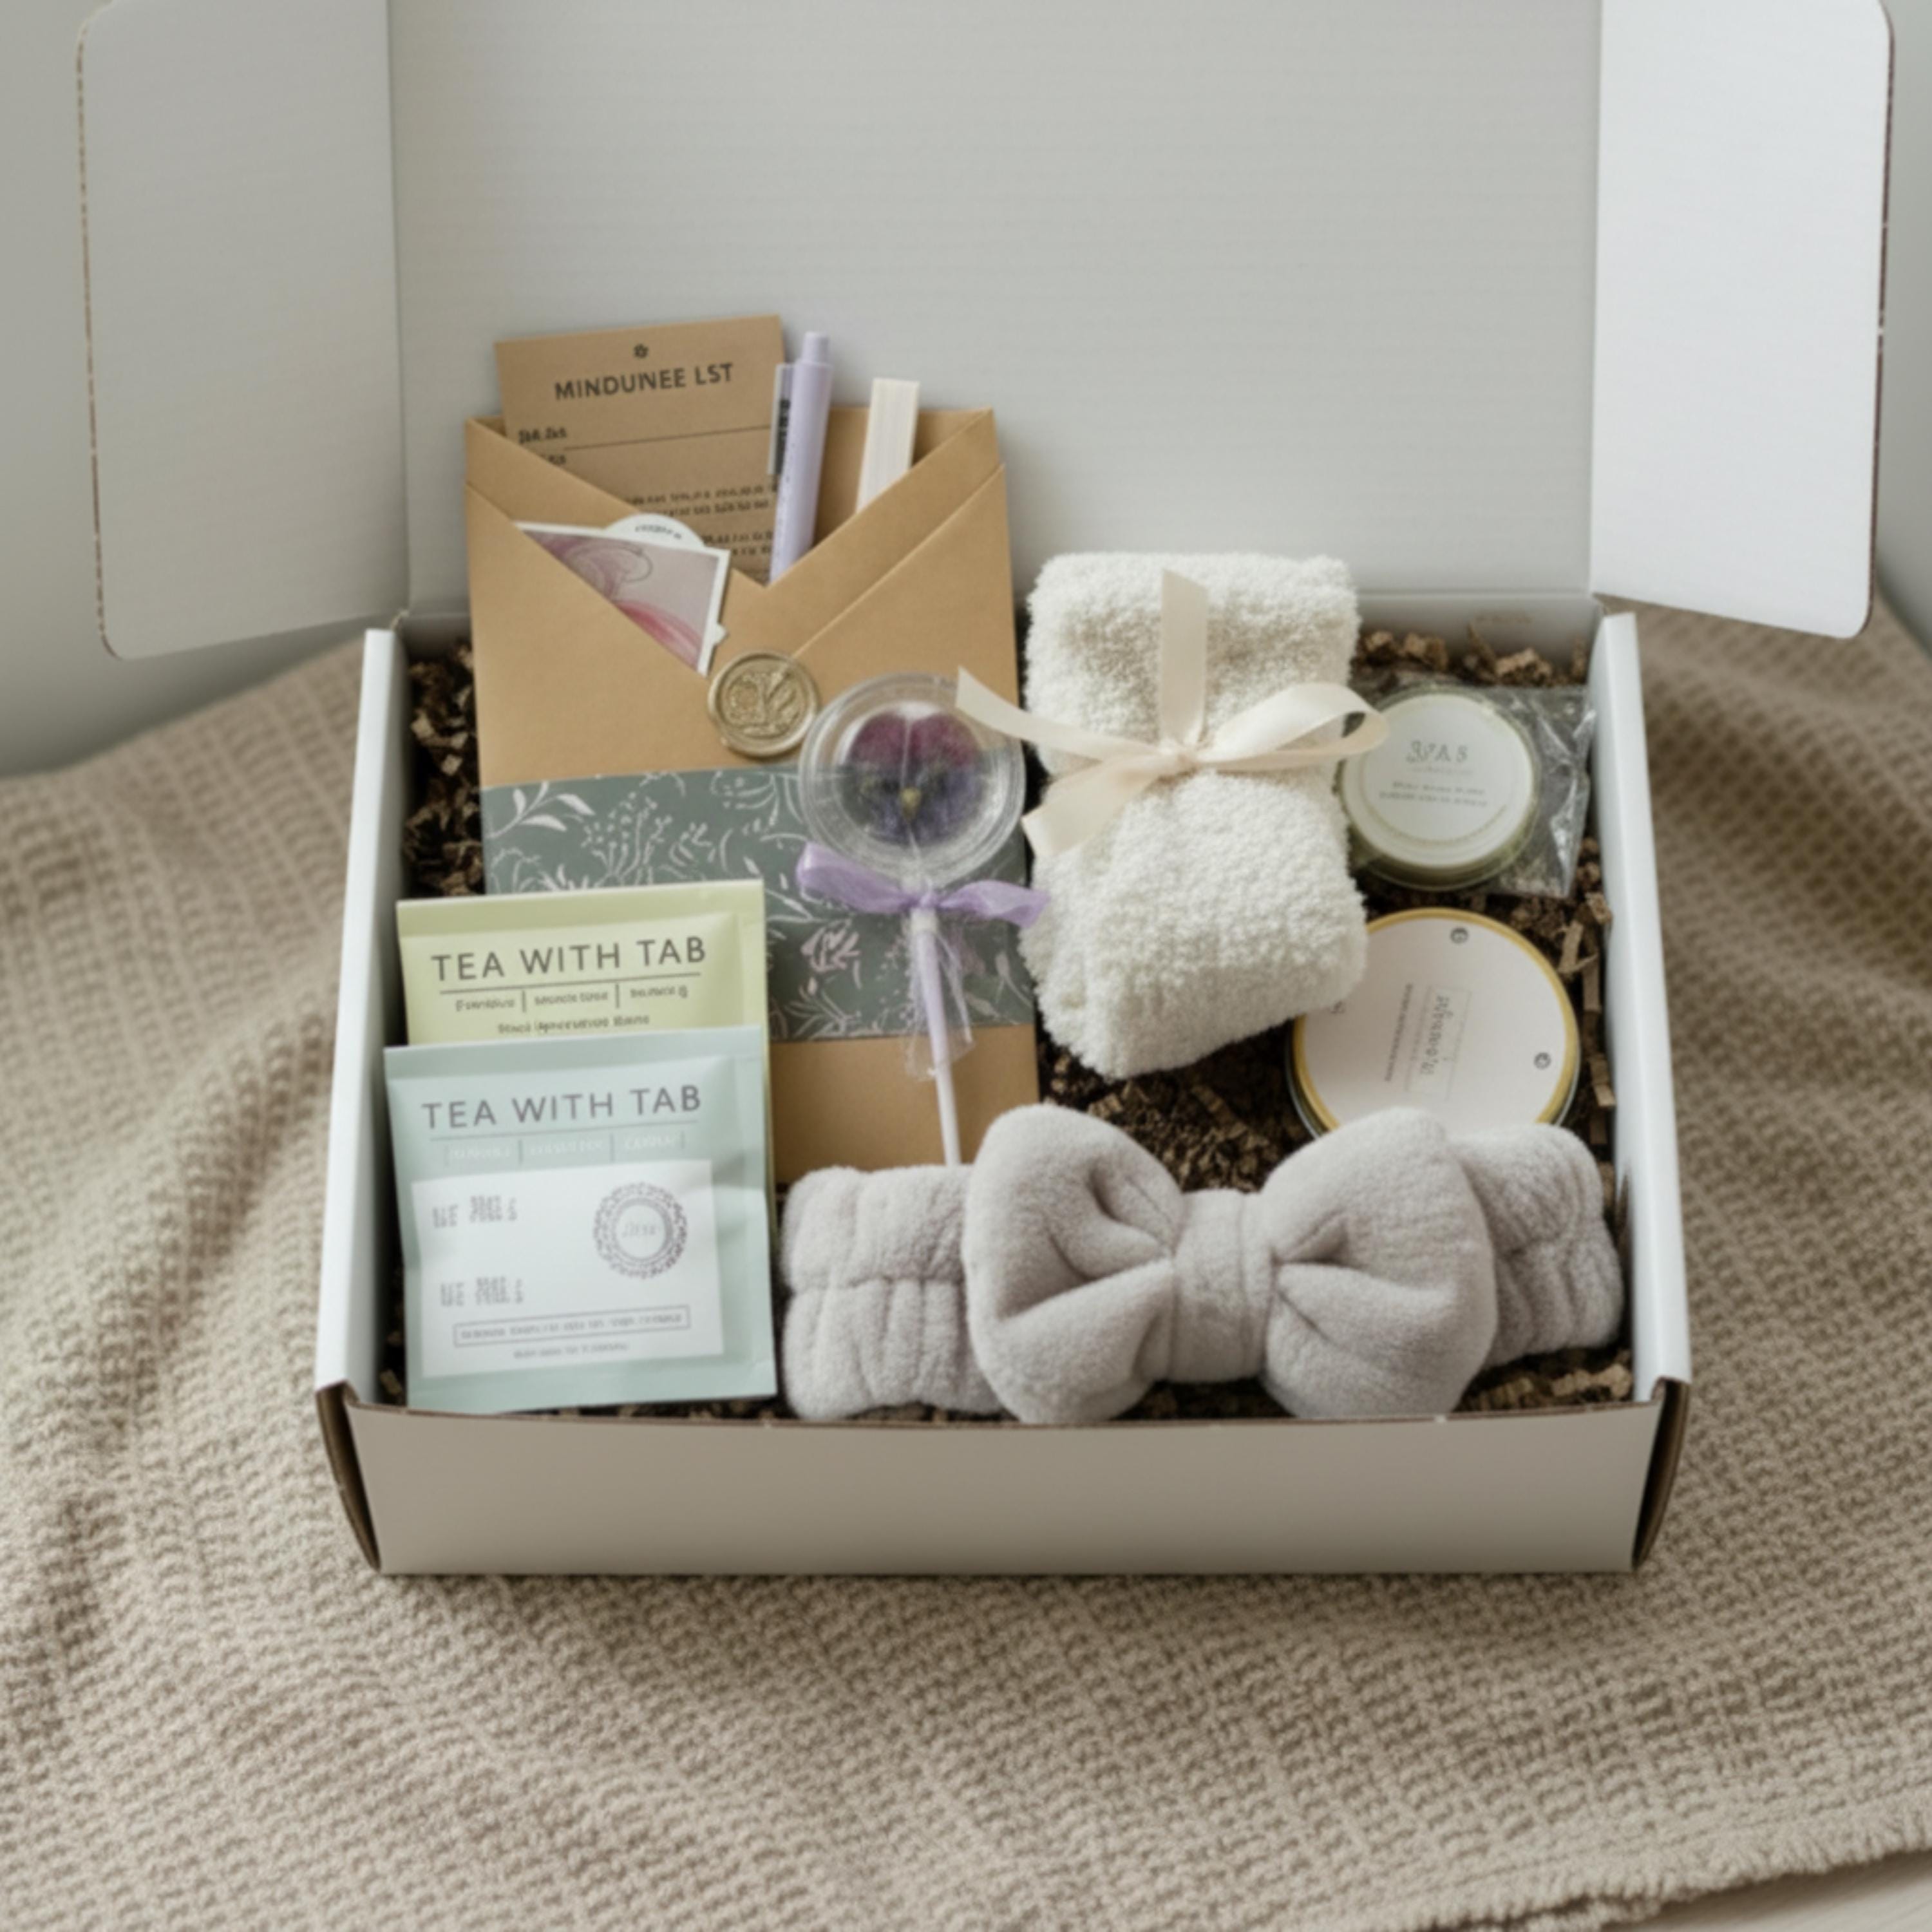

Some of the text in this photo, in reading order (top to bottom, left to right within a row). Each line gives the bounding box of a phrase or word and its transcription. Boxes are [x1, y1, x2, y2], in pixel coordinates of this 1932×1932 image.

[694, 361, 734, 386] LST
[430, 935, 706, 983] TEA WITH TAB
[421, 1084, 702, 1130] TEA WITH TAB
